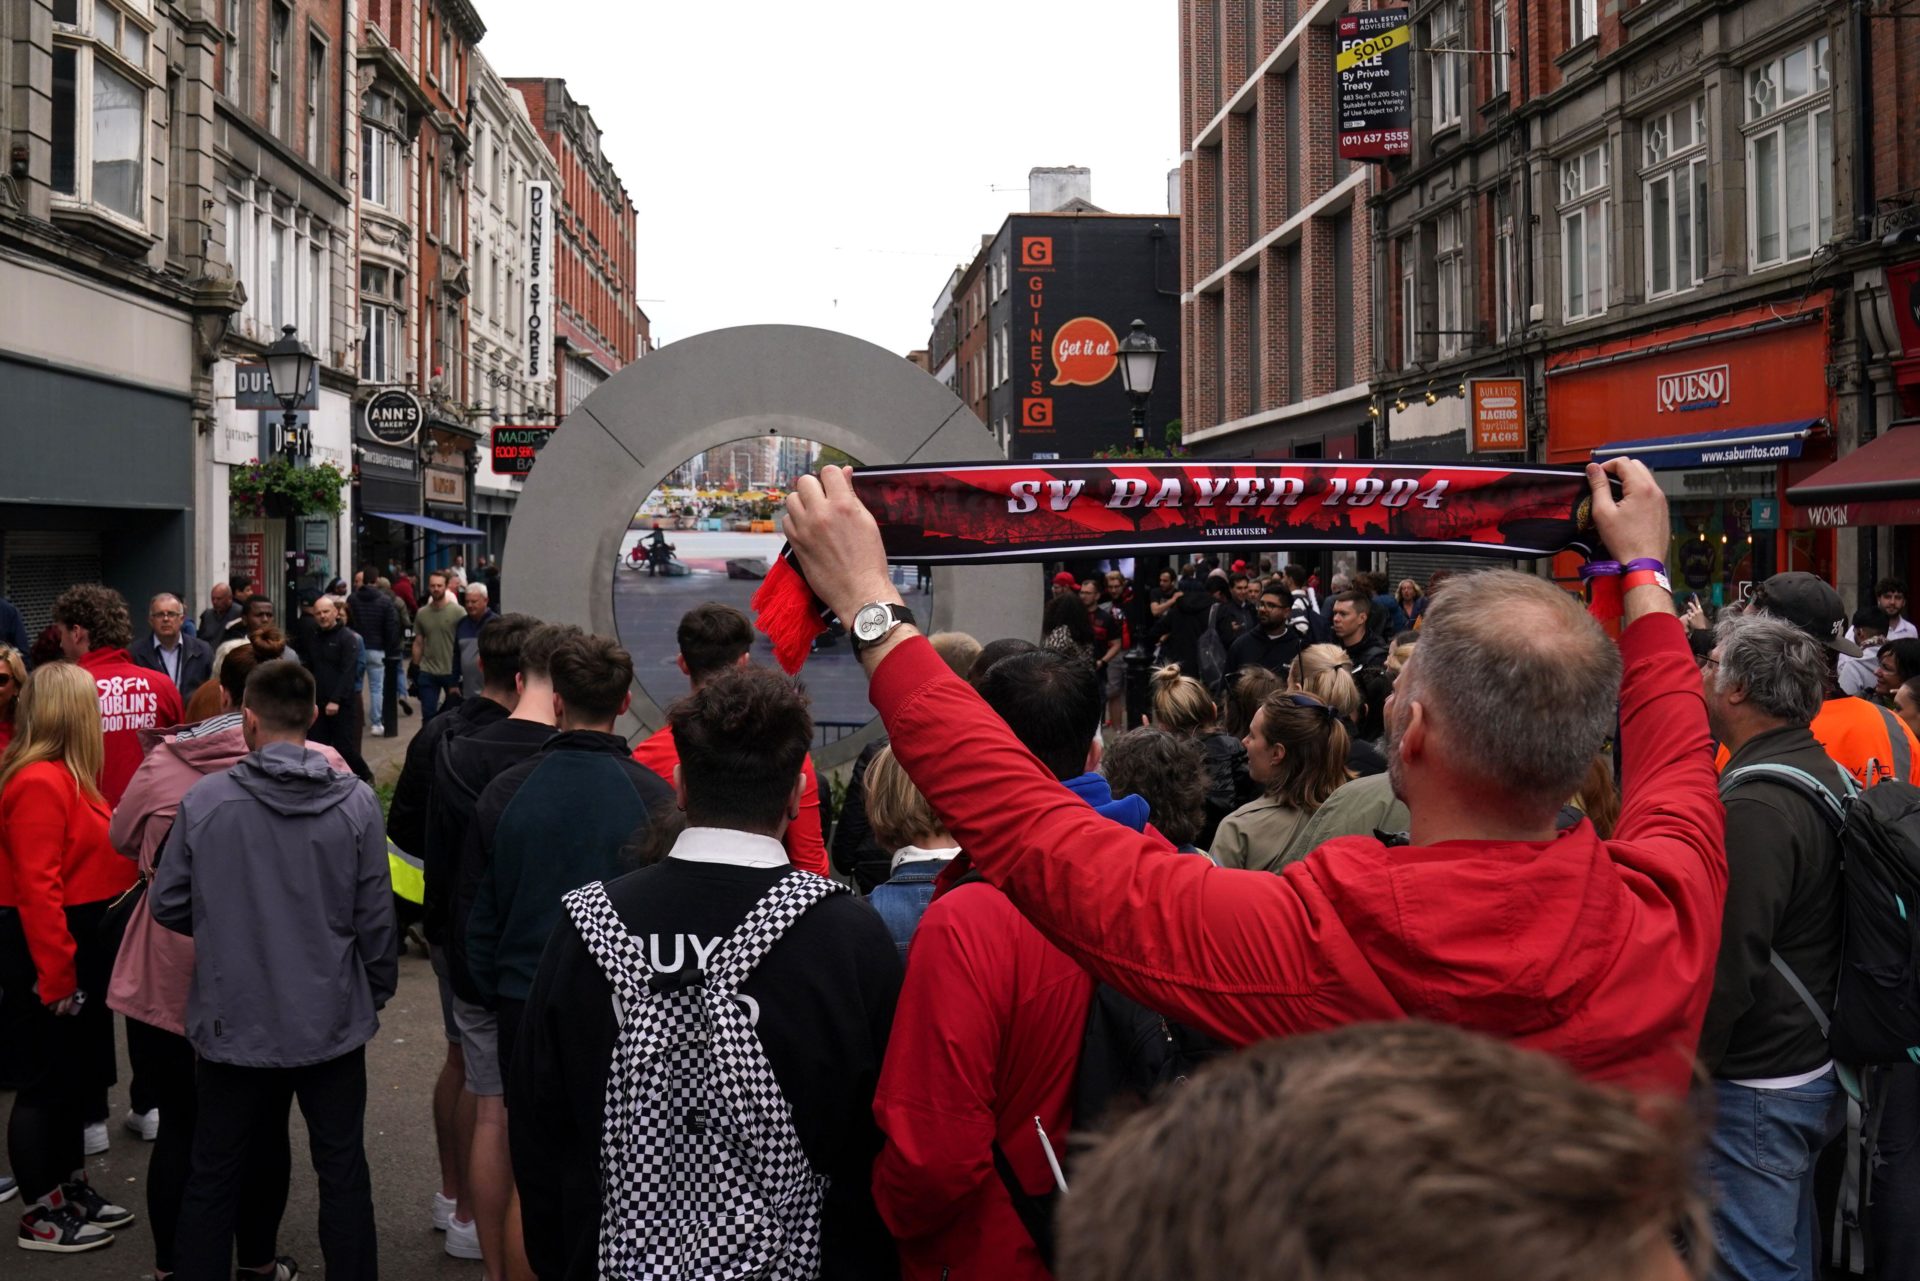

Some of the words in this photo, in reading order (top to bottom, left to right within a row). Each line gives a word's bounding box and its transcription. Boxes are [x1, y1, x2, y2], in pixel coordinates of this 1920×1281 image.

[1340, 22, 1356, 30] QRE
[1360, 22, 1394, 30] ADVISERS
[1353, 36, 1393, 60] SOLD
[1342, 72, 1354, 82] By
[1357, 69, 1389, 79] Private
[1342, 82, 1372, 91] Treaty
[1383, 98, 1404, 106] Variety
[1363, 108, 1385, 116] Subject
[1343, 135, 1361, 146] (01)
[1364, 133, 1382, 143] 637
[1384, 131, 1409, 141] 5555
[1384, 141, 1408, 151] qre.ie
[530, 186, 543, 278] DUNNES
[1027, 240, 1046, 262] G
[528, 283, 541, 377] STORES
[1029, 276, 1043, 395] GUINEYS
[1060, 339, 1081, 362] Get
[1083, 339, 1094, 356] it
[1096, 340, 1110, 356] at
[1480, 386, 1517, 397] BURRITOS
[1661, 371, 1725, 411] QUESO
[371, 407, 417, 420] ANN'S
[1027, 401, 1047, 422] G
[1480, 409, 1518, 420] NACHOS
[1481, 432, 1519, 442] TACOS
[496, 446, 518, 458] FOOD
[1701, 445, 1789, 463] www.saburritos.com
[1007, 479, 1086, 513] SV
[1104, 478, 1305, 508] BAYER
[1321, 478, 1450, 509] 1904
[1807, 504, 1848, 526] WOKIN
[1205, 528, 1267, 537] LEVERKUSEN
[96, 676, 150, 700] 98FM
[102, 715, 123, 733] OOD
[125, 713, 157, 730] TIMES
